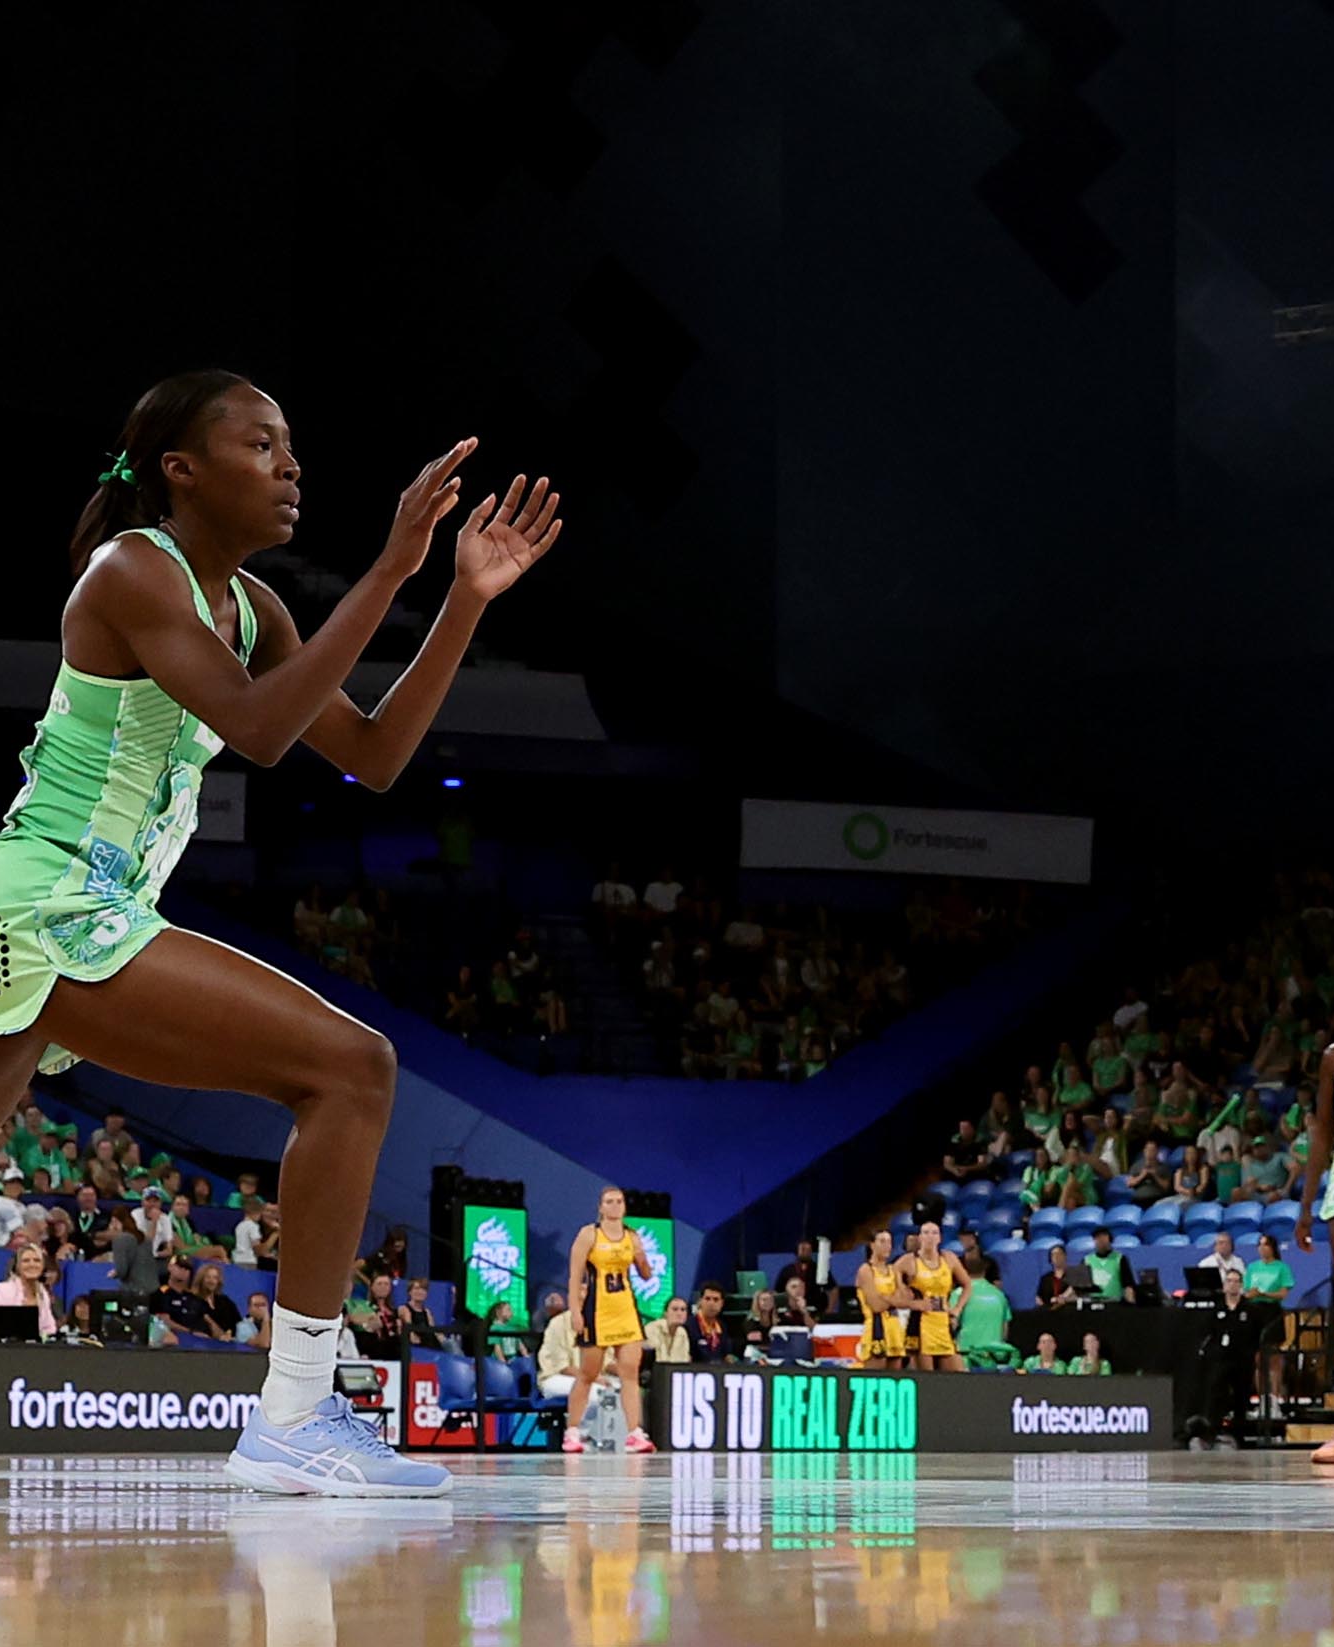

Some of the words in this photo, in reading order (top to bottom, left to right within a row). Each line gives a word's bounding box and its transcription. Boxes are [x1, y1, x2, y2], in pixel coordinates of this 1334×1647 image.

[8, 1378, 260, 1430] fortescue.com
[670, 1371, 716, 1449] US
[724, 1373, 763, 1450] TO
[771, 1375, 841, 1449] REAL
[847, 1377, 917, 1449] ZERO
[1012, 1397, 1149, 1434] fortescue.com
